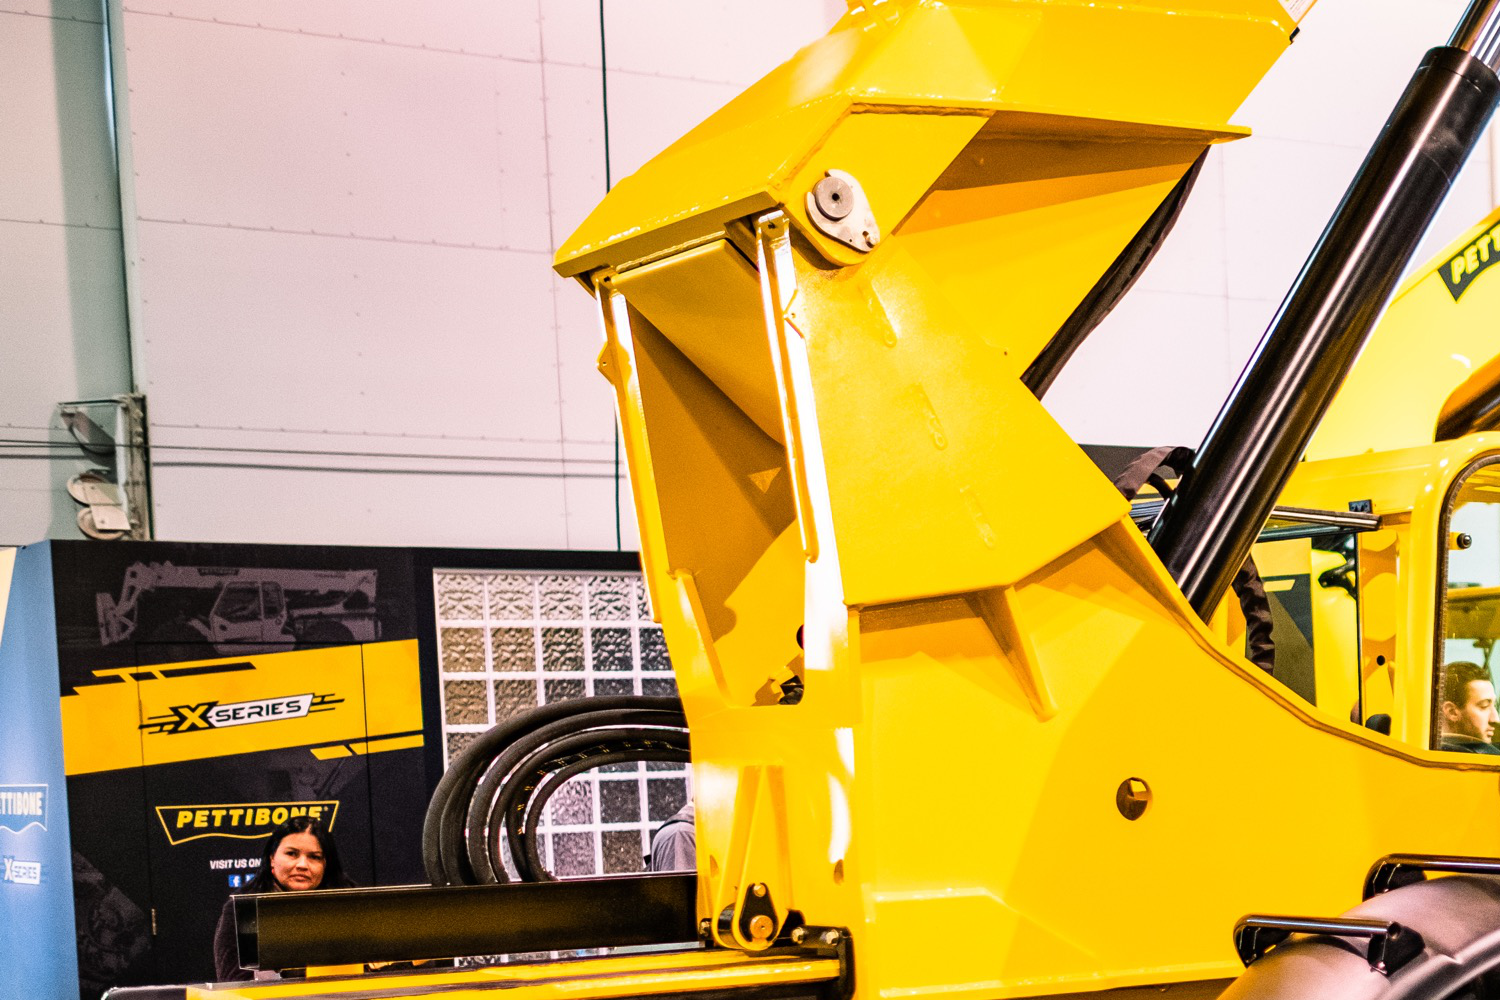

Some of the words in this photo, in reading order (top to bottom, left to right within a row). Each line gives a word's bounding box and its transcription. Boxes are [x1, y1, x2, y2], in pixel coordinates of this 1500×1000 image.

[0, 791, 43, 816] TTIBONE
[209, 859, 234, 870] VISIT
[234, 858, 247, 868] US
[248, 858, 261, 868] ON
